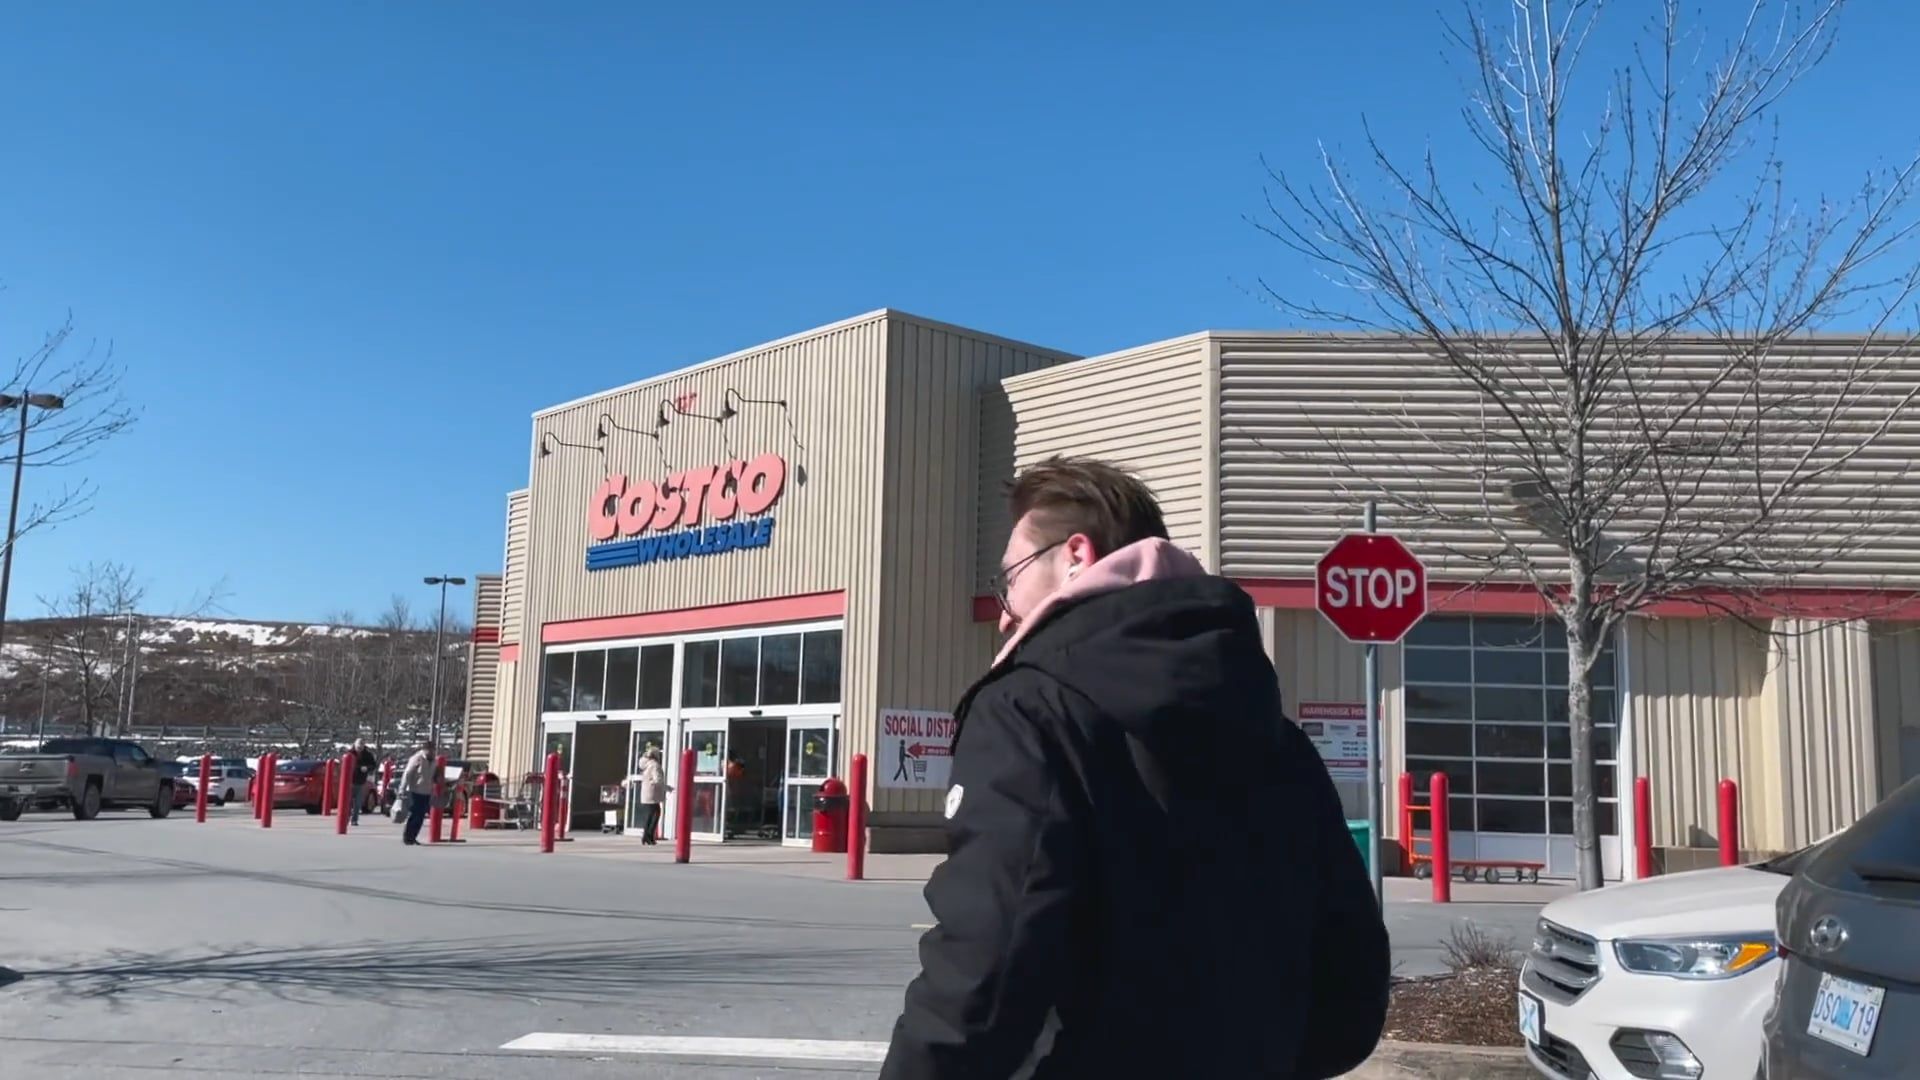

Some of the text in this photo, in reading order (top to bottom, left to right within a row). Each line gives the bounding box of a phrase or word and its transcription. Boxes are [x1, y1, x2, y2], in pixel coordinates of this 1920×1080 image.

[589, 452, 786, 540] COSTCO
[638, 517, 774, 564] WHOLESALE
[1326, 566, 1417, 609] STOP
[884, 714, 924, 737] SOCIAL
[1845, 1000, 1876, 1036] 719
